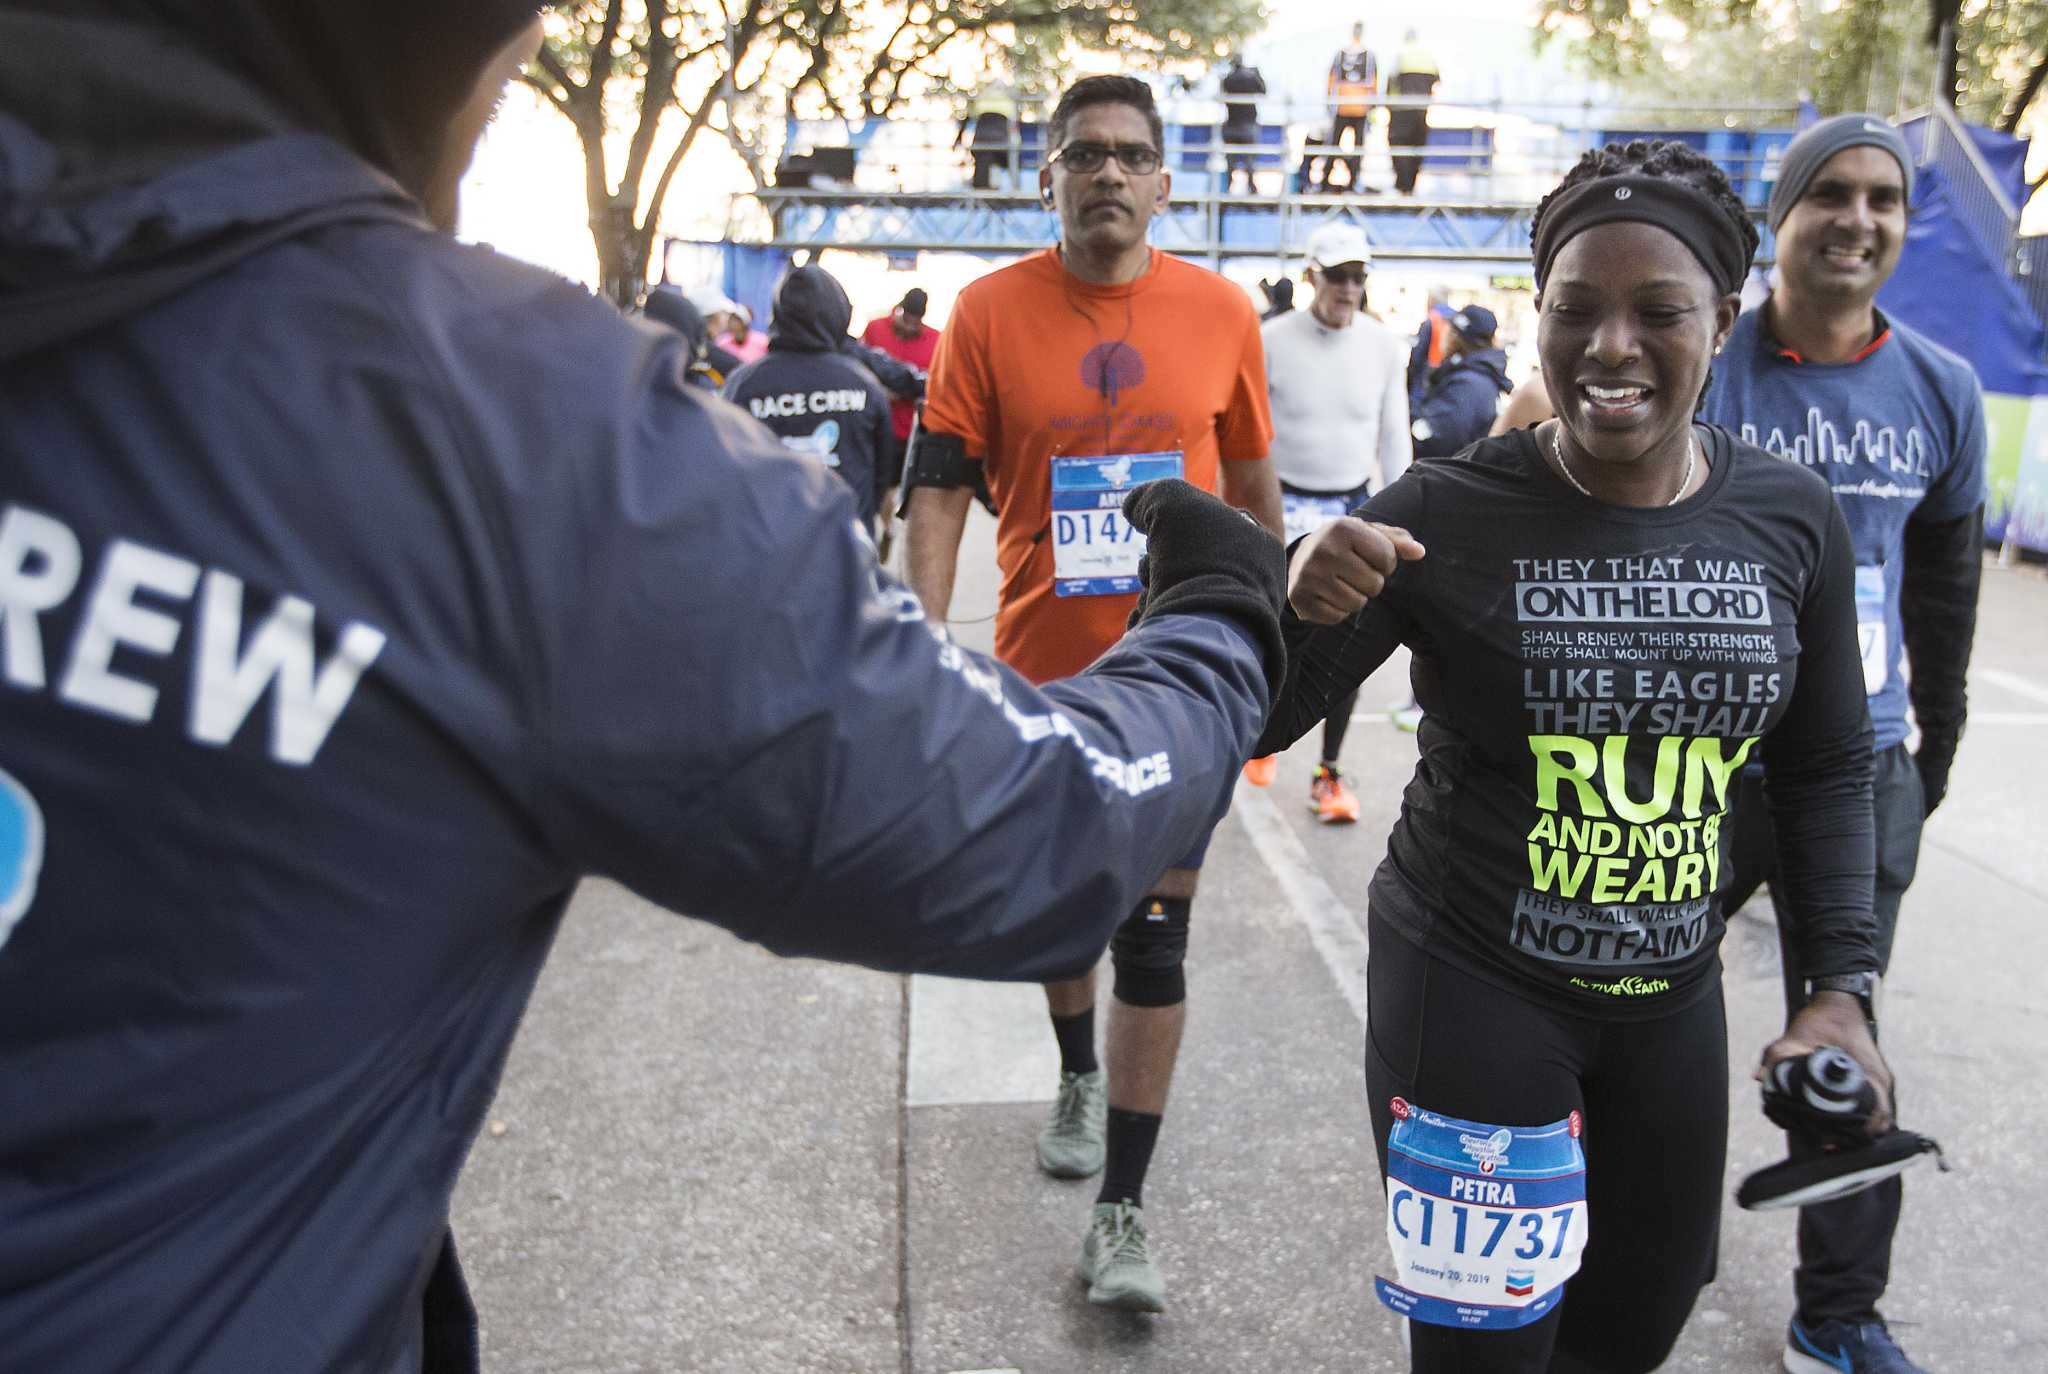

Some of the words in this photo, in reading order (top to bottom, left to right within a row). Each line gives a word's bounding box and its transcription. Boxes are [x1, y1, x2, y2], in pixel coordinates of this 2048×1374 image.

[808, 389, 867, 413] CREW
[1513, 558, 1595, 580] THEY
[1606, 558, 1684, 580] THAT
[1696, 559, 1765, 584] WAIT
[1668, 587, 1764, 619] LORD
[1521, 631, 1573, 646] SHALL
[1577, 632, 1635, 647] RENEW
[1639, 632, 1686, 647] THEIR
[1522, 647, 1560, 660] THEY
[1565, 647, 1609, 660] SHALL
[1614, 648, 1668, 661] MOUNT
[1672, 648, 1692, 661] UP
[1696, 649, 1735, 662] WITH
[1738, 651, 1778, 664] WINGS
[1523, 668, 1616, 698] LIKE
[1635, 669, 1781, 704] EAGLES
[1524, 702, 1644, 735] THEY
[1646, 704, 1768, 738] SHALL
[1527, 735, 1761, 824] RUN
[1526, 812, 1622, 855] AND
[1627, 820, 1701, 858] NOT
[1527, 842, 1719, 904] WEARY
[1523, 890, 1575, 917] THEY
[1577, 906, 1632, 925] SHALL
[1637, 905, 1683, 922] WALK
[1514, 912, 1614, 960] NOT
[1613, 913, 1705, 960] FAINT
[1450, 1176, 1516, 1206] PETRA
[1392, 1189, 1574, 1260] C11737
[1411, 1261, 1444, 1280] January
[1447, 1269, 1463, 1282] 20,
[1466, 1272, 1490, 1284] 2019
